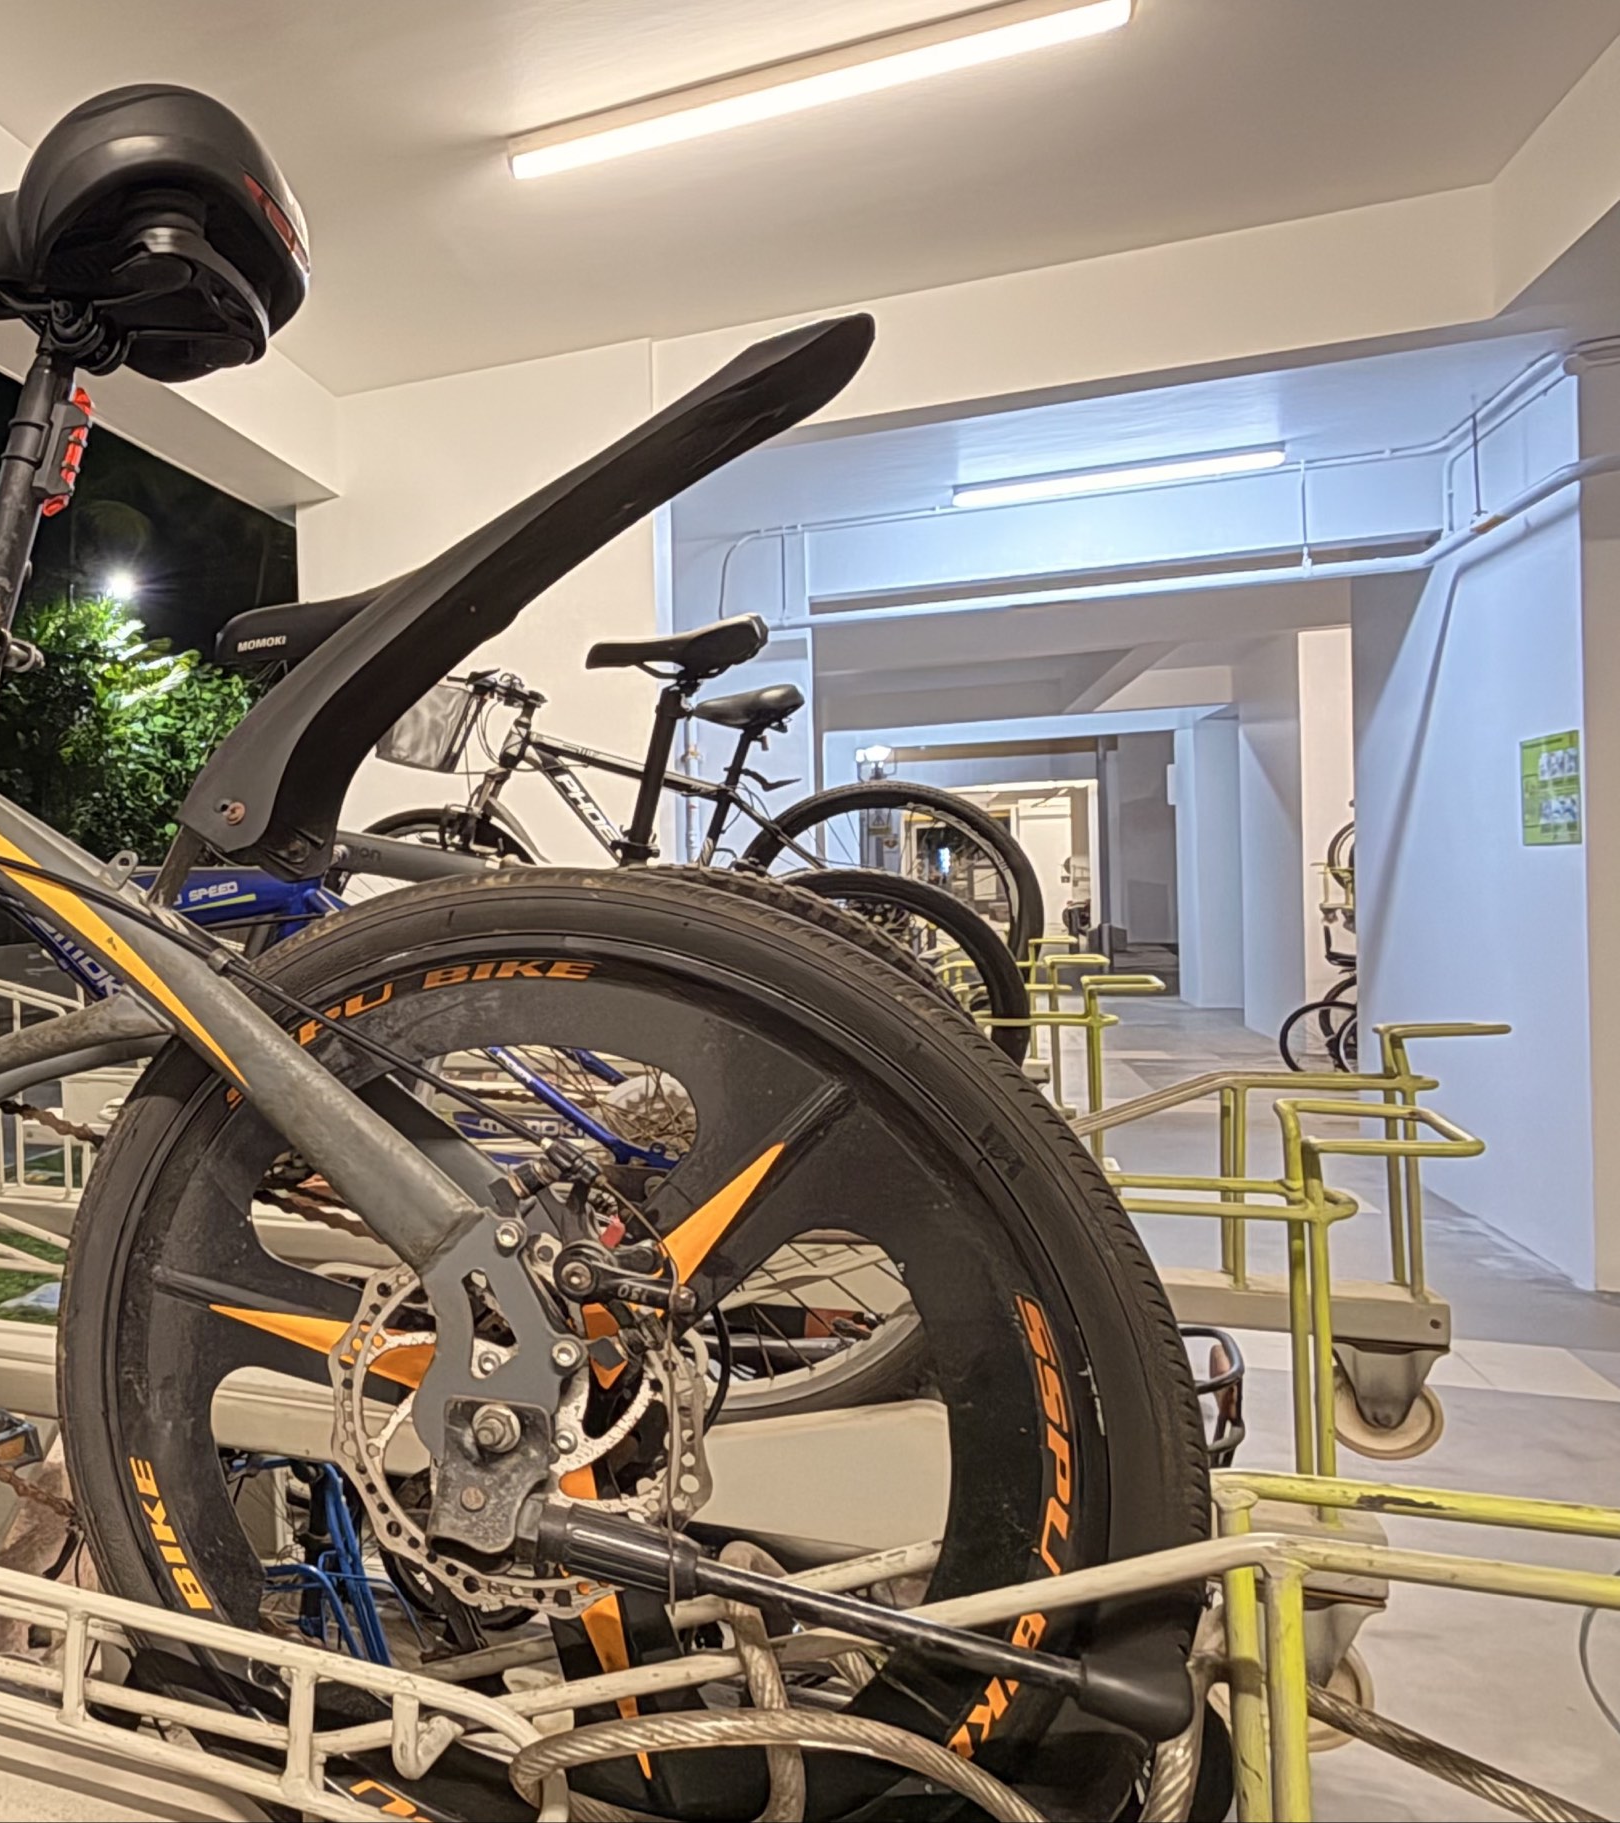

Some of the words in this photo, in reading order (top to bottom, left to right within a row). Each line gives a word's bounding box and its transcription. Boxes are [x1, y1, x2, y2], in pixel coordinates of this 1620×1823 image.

[236, 635, 287, 653] MOMOKI
[554, 772, 623, 845] PHOE
[188, 880, 239, 902] SPEED
[423, 960, 597, 990] BIKE
[1016, 1293, 1073, 1575] SSPU
[129, 1456, 213, 1610] BIKE
[947, 1611, 1048, 1758] BKE
